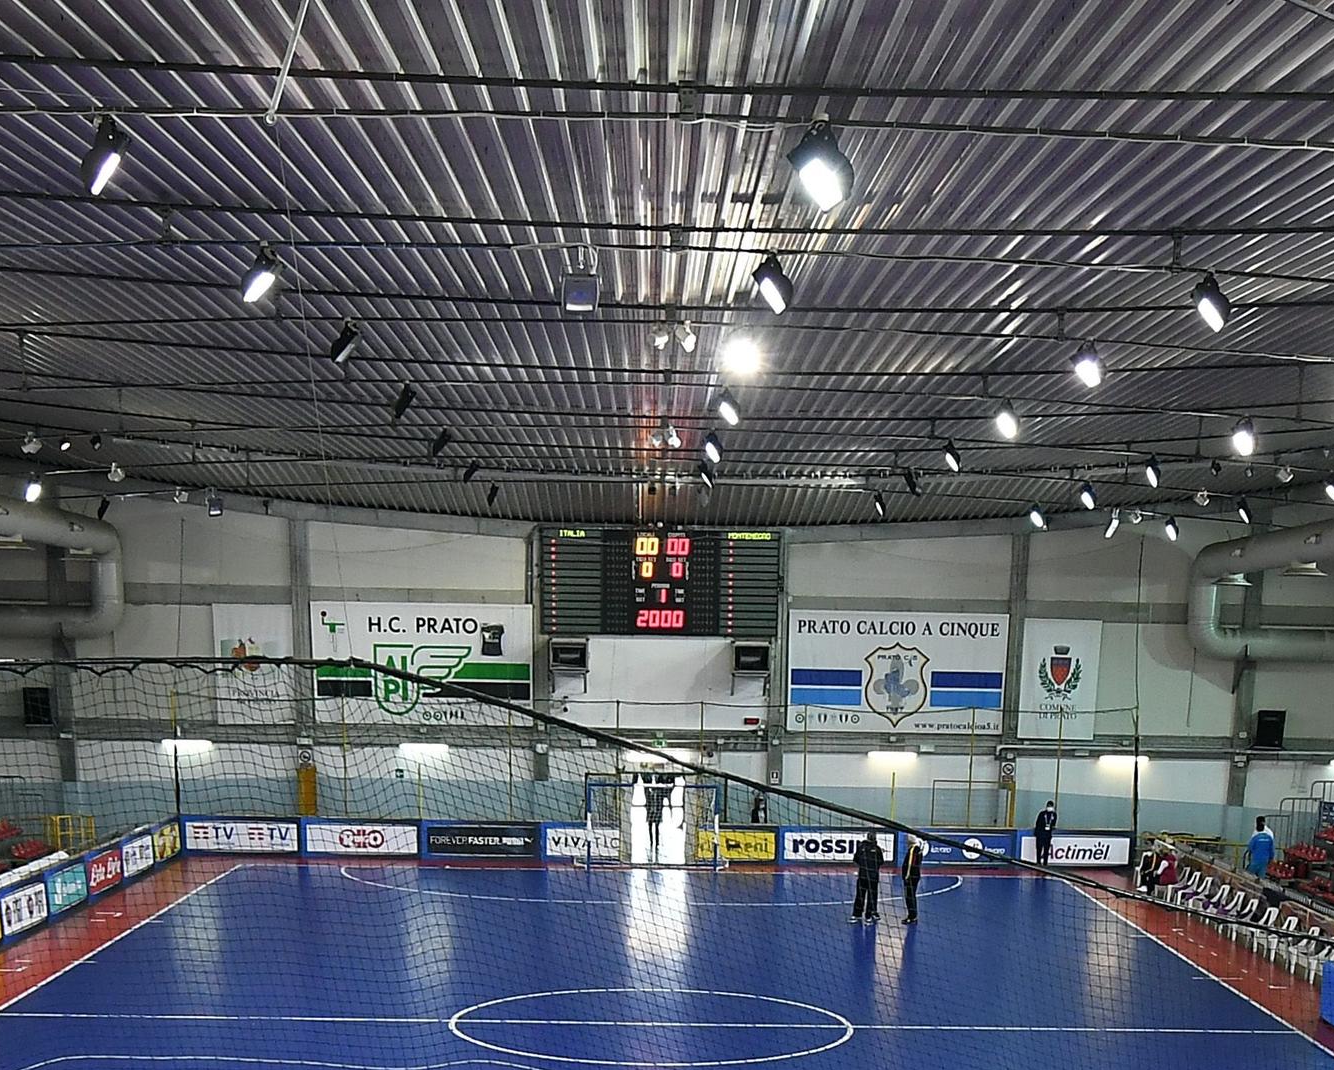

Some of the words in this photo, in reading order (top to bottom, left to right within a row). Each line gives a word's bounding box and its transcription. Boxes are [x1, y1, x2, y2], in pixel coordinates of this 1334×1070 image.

[559, 529, 586, 538] ITALIA
[635, 537, 659, 555] 00
[666, 537, 691, 555] 00
[641, 561, 653, 578] 0
[671, 562, 683, 578] 0
[368, 616, 406, 634] H.C.
[416, 616, 478, 634] PRATO
[636, 609, 685, 628] 2000
[797, 619, 851, 636] PRATO
[856, 620, 917, 636] CALCIO
[921, 620, 933, 636] A
[939, 621, 1000, 638] CINQUE
[744, 838, 768, 853] eni
[792, 838, 858, 854] rossi
